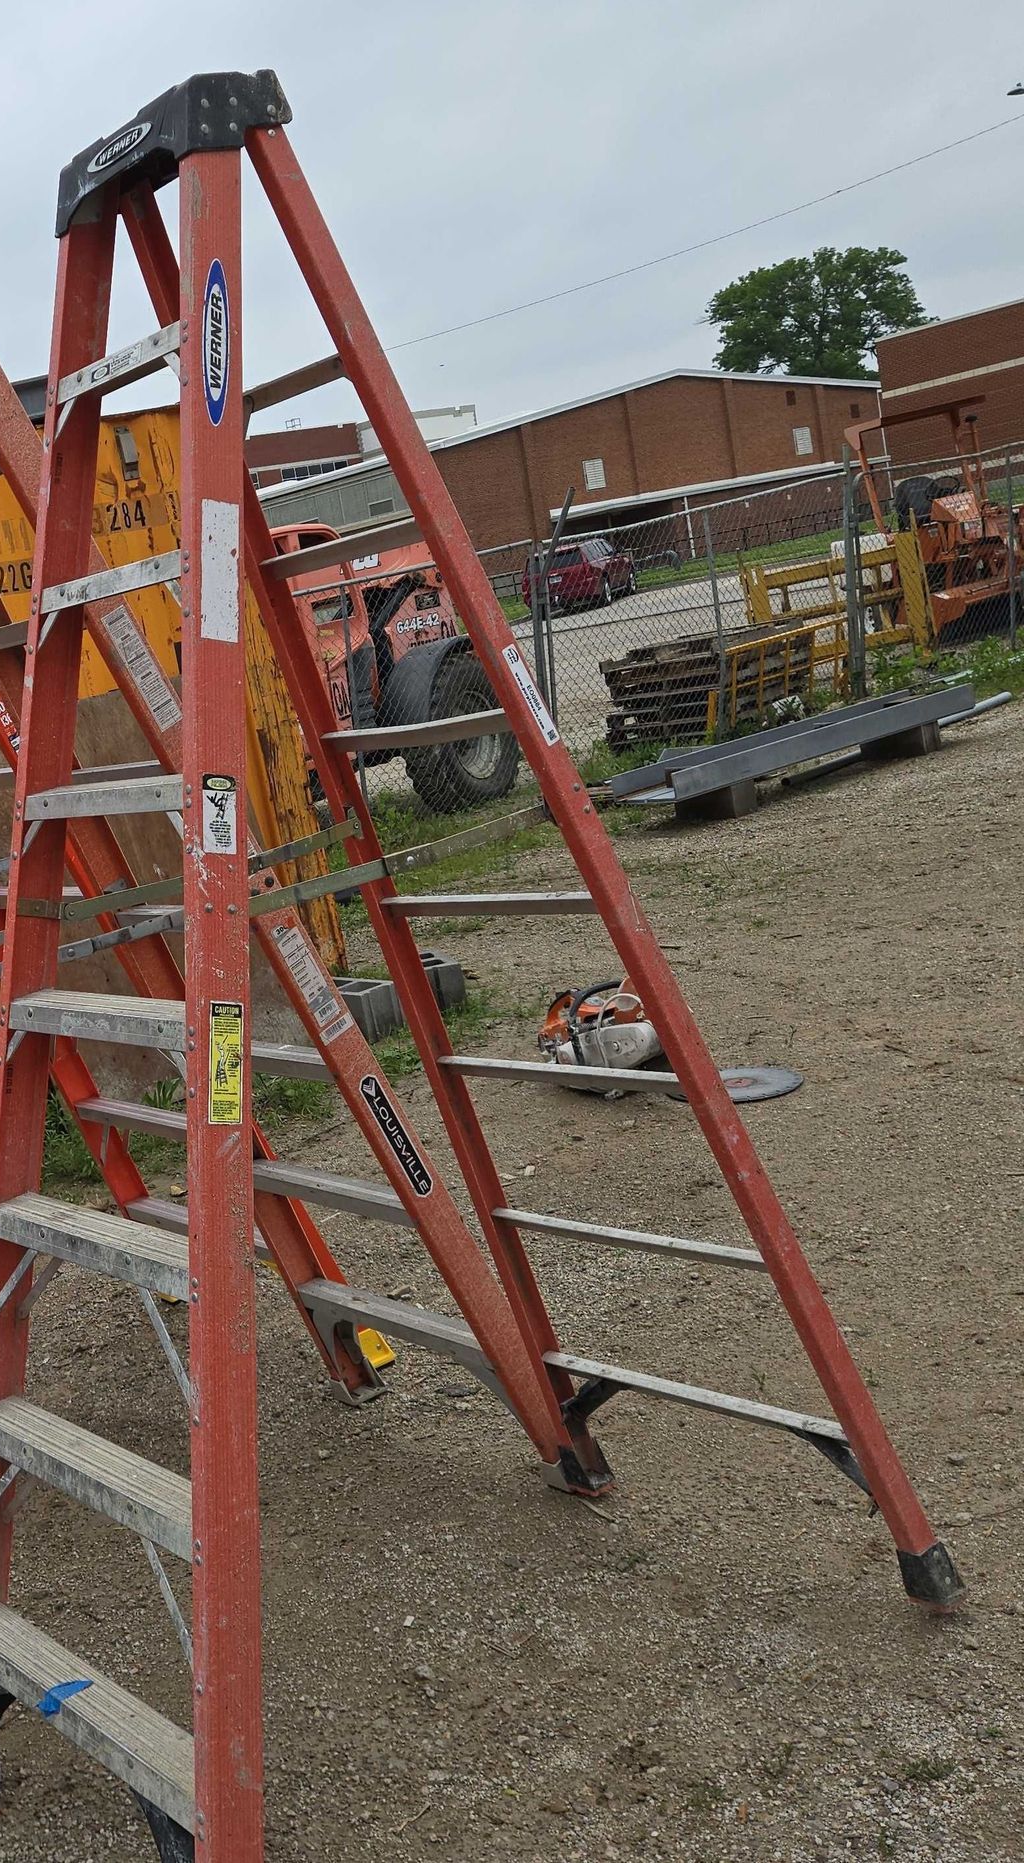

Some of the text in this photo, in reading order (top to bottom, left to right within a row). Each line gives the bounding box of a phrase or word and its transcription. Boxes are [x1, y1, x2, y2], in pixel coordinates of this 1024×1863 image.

[98, 128, 140, 163] WERNER
[207, 292, 224, 391] WERNER
[214, 1005, 240, 1016] CAUTION
[370, 1098, 429, 1195] LOUISVILLE
